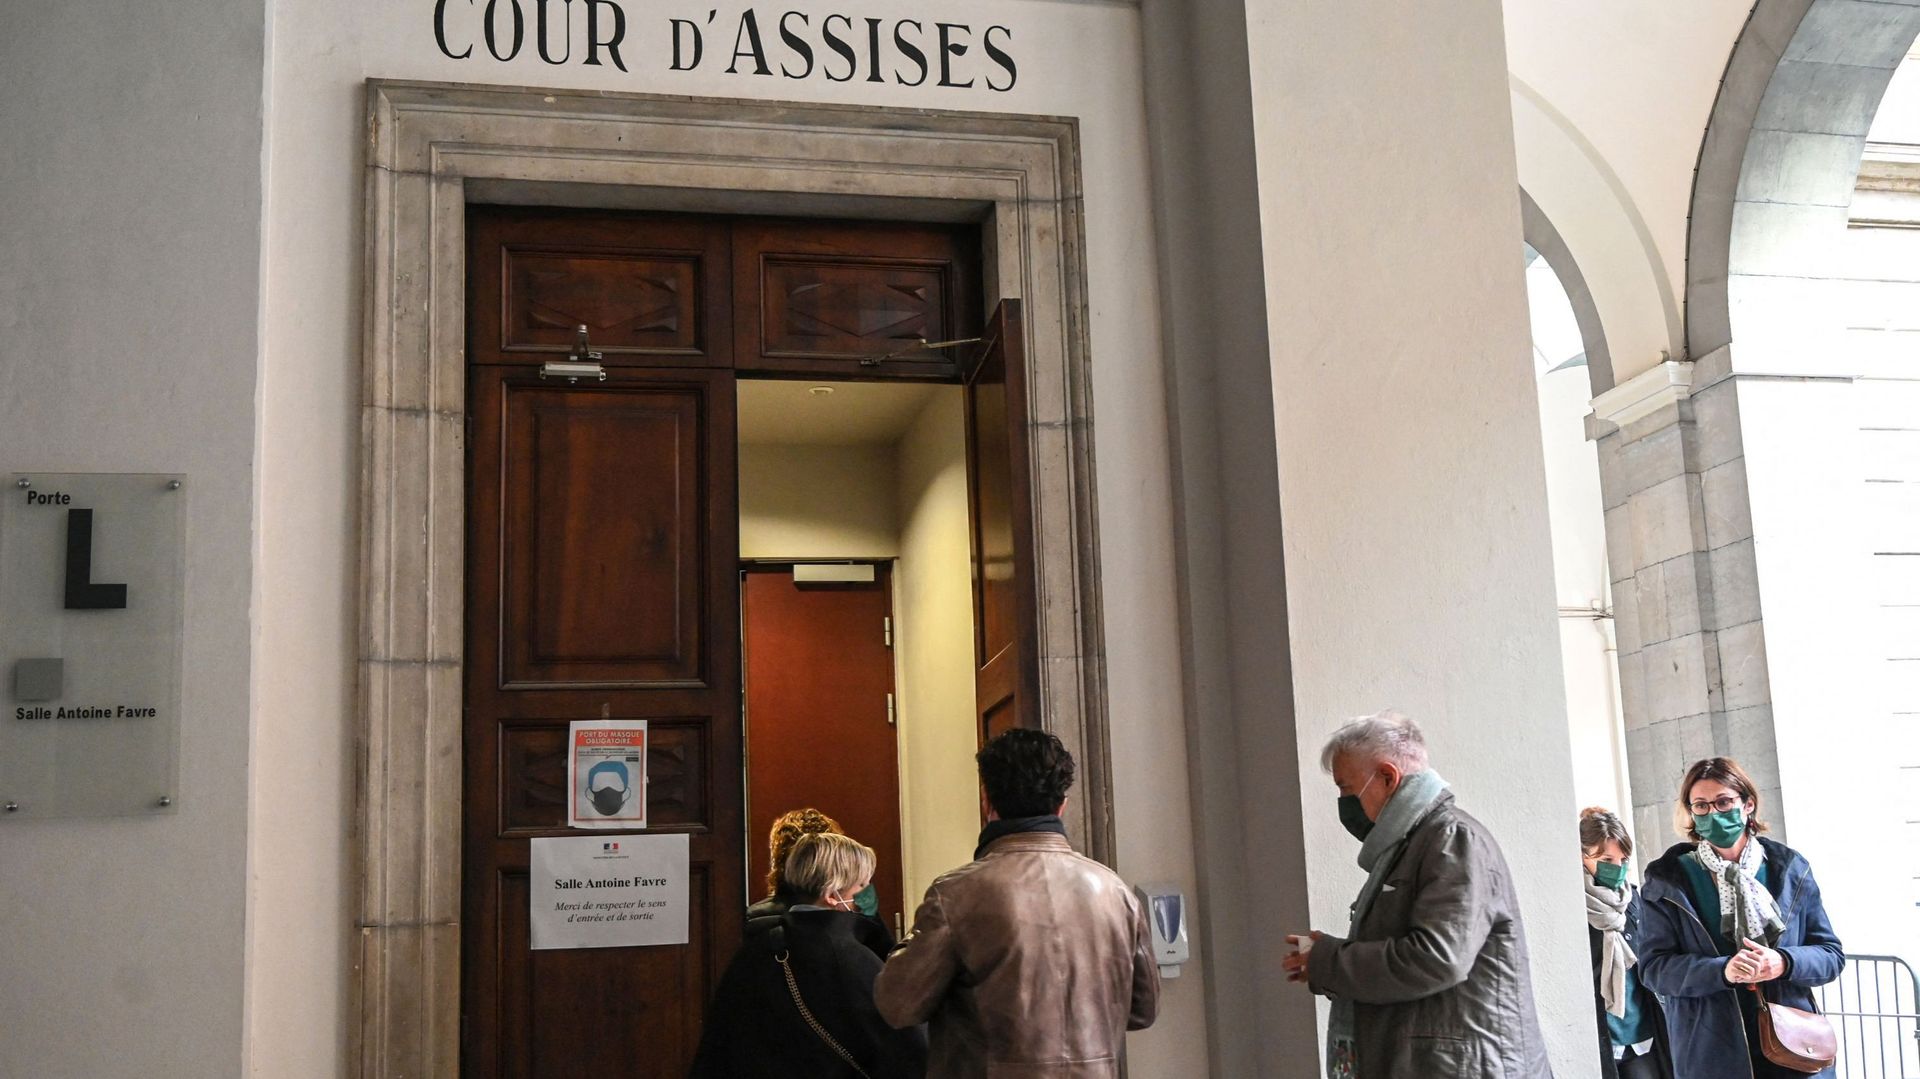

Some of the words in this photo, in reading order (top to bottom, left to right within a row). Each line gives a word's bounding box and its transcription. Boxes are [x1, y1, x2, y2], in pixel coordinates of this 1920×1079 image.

[434, 0, 628, 73] COUR
[670, 8, 1017, 92] D'ASSISES
[27, 491, 71, 505] Porte
[65, 509, 127, 609] L
[16, 707, 52, 720] Salle
[56, 706, 112, 719] Antoine
[117, 706, 156, 718] Favre
[555, 879, 583, 889] Salle
[585, 878, 631, 888] Antoine
[634, 876, 667, 887] Favre
[555, 902, 580, 911] Merci
[583, 901, 593, 910] de
[595, 901, 635, 911] respecter
[637, 900, 647, 908] le
[648, 900, 667, 908] sens
[606, 913, 615, 922] et
[616, 912, 627, 921] de
[629, 912, 654, 920] sortie
